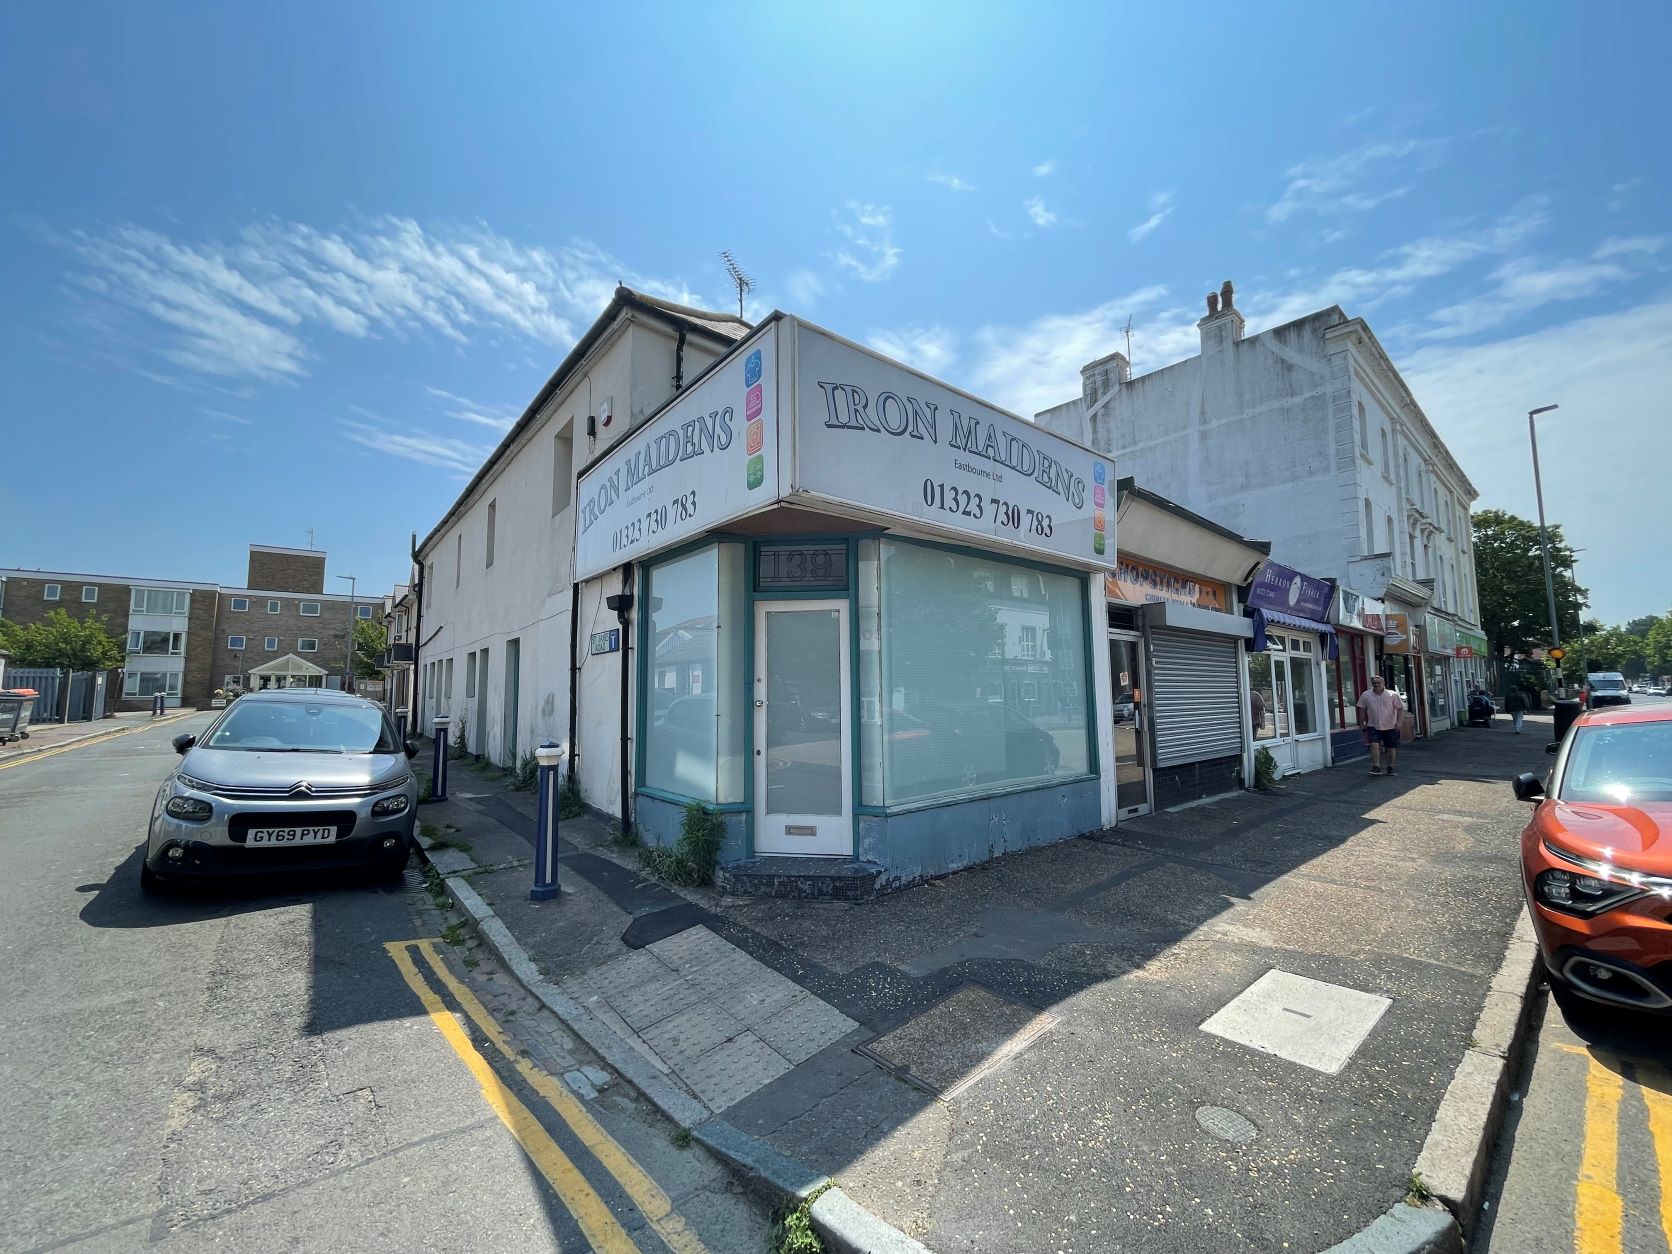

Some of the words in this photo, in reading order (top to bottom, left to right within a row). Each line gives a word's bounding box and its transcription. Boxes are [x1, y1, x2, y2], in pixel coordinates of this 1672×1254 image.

[581, 470, 621, 536] IRON
[624, 406, 734, 492] MAIDENS
[818, 381, 939, 445] IRON
[948, 409, 1086, 510] MAIDENS
[954, 458, 991, 481] Eastbourne
[992, 471, 1003, 484] Ltd
[612, 518, 643, 553] 01323
[646, 508, 667, 537] 730
[671, 489, 697, 525] 783
[923, 478, 984, 520] 01323
[990, 498, 1021, 530] 730
[1025, 509, 1054, 538] 783
[772, 549, 833, 583] 139
[253, 829, 297, 843] GY69
[300, 827, 331, 841] PYD
